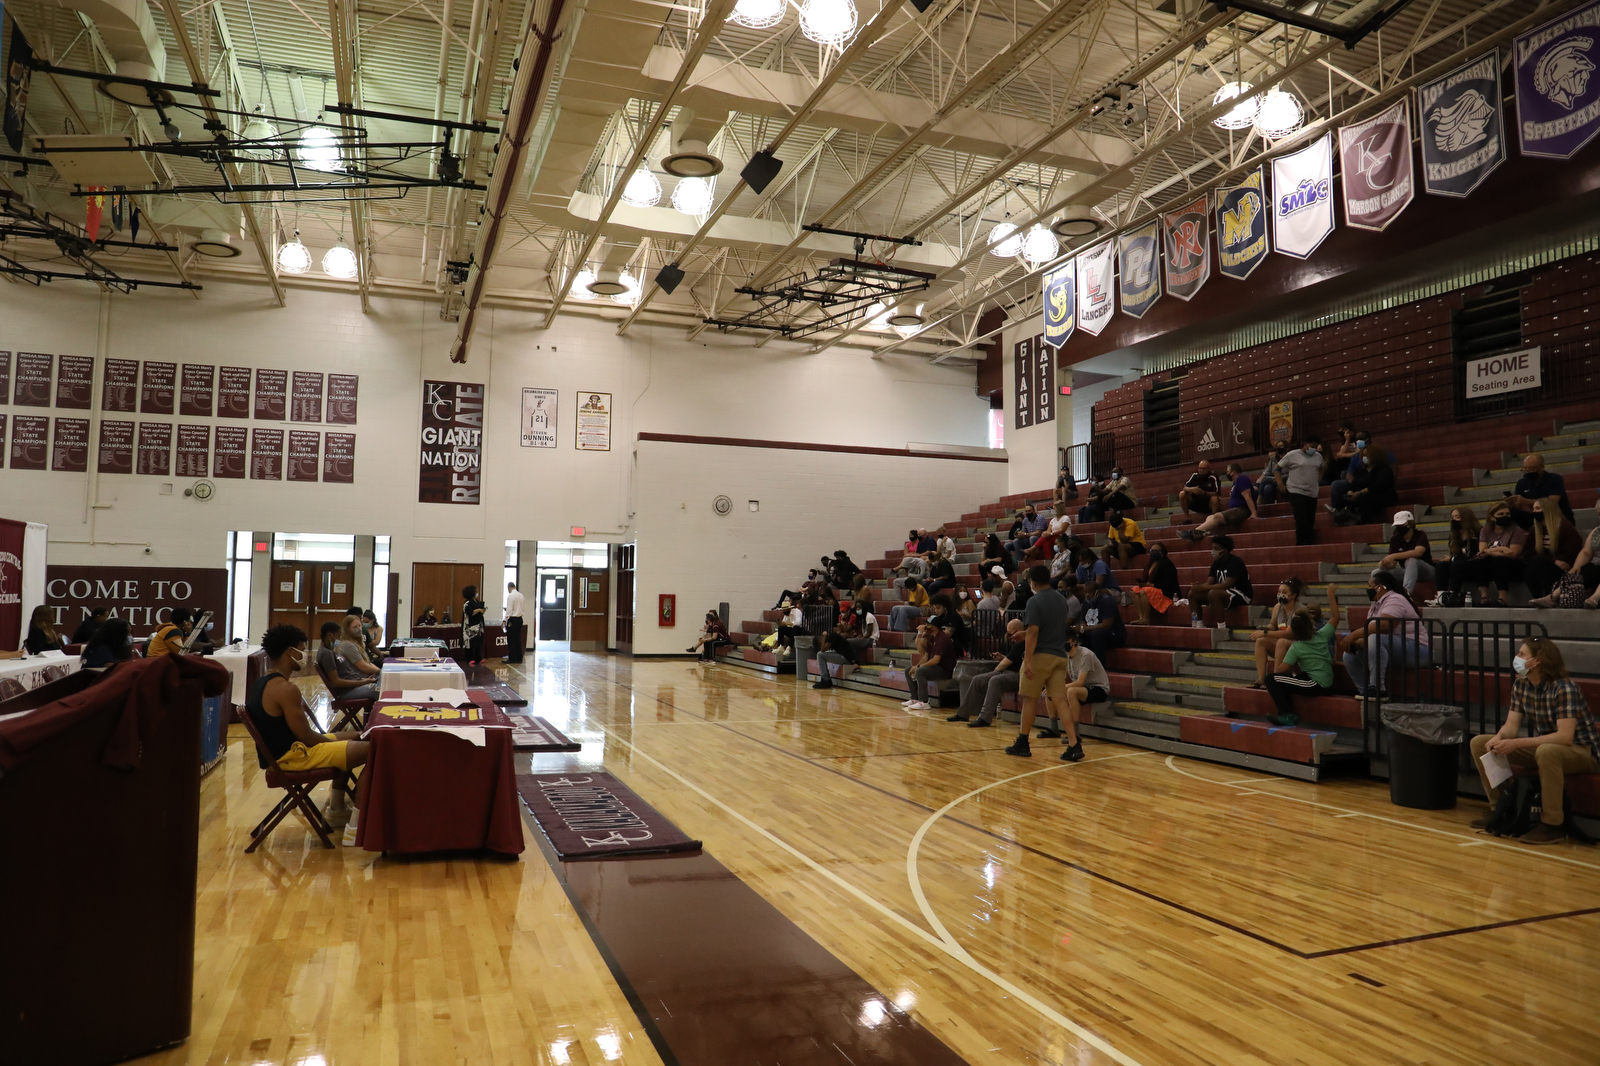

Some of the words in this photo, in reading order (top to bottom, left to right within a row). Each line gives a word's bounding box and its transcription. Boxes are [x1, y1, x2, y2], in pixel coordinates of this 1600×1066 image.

[1424, 82, 1447, 114] LOY
[1446, 56, 1495, 91] NORRIX
[1523, 98, 1600, 141] SPARTAN
[1428, 135, 1499, 181] KNIGHTS
[1348, 195, 1380, 216] MAROON
[1380, 175, 1410, 209] GIANTS
[1221, 234, 1264, 266] WILDCATS
[1082, 298, 1111, 320] LANCERS
[1046, 314, 1073, 336] BEARS
[1040, 336, 1049, 420] NATION
[1477, 354, 1529, 377] HOME
[1020, 342, 1028, 426] GIANT
[1472, 380, 1508, 392] Seating
[1512, 375, 1535, 385] Area
[424, 383, 452, 421] KC
[422, 427, 482, 447] GIANT
[1198, 441, 1219, 452] adidas
[422, 451, 479, 467] NATION
[47, 578, 139, 599] COME
[152, 580, 193, 600] TO
